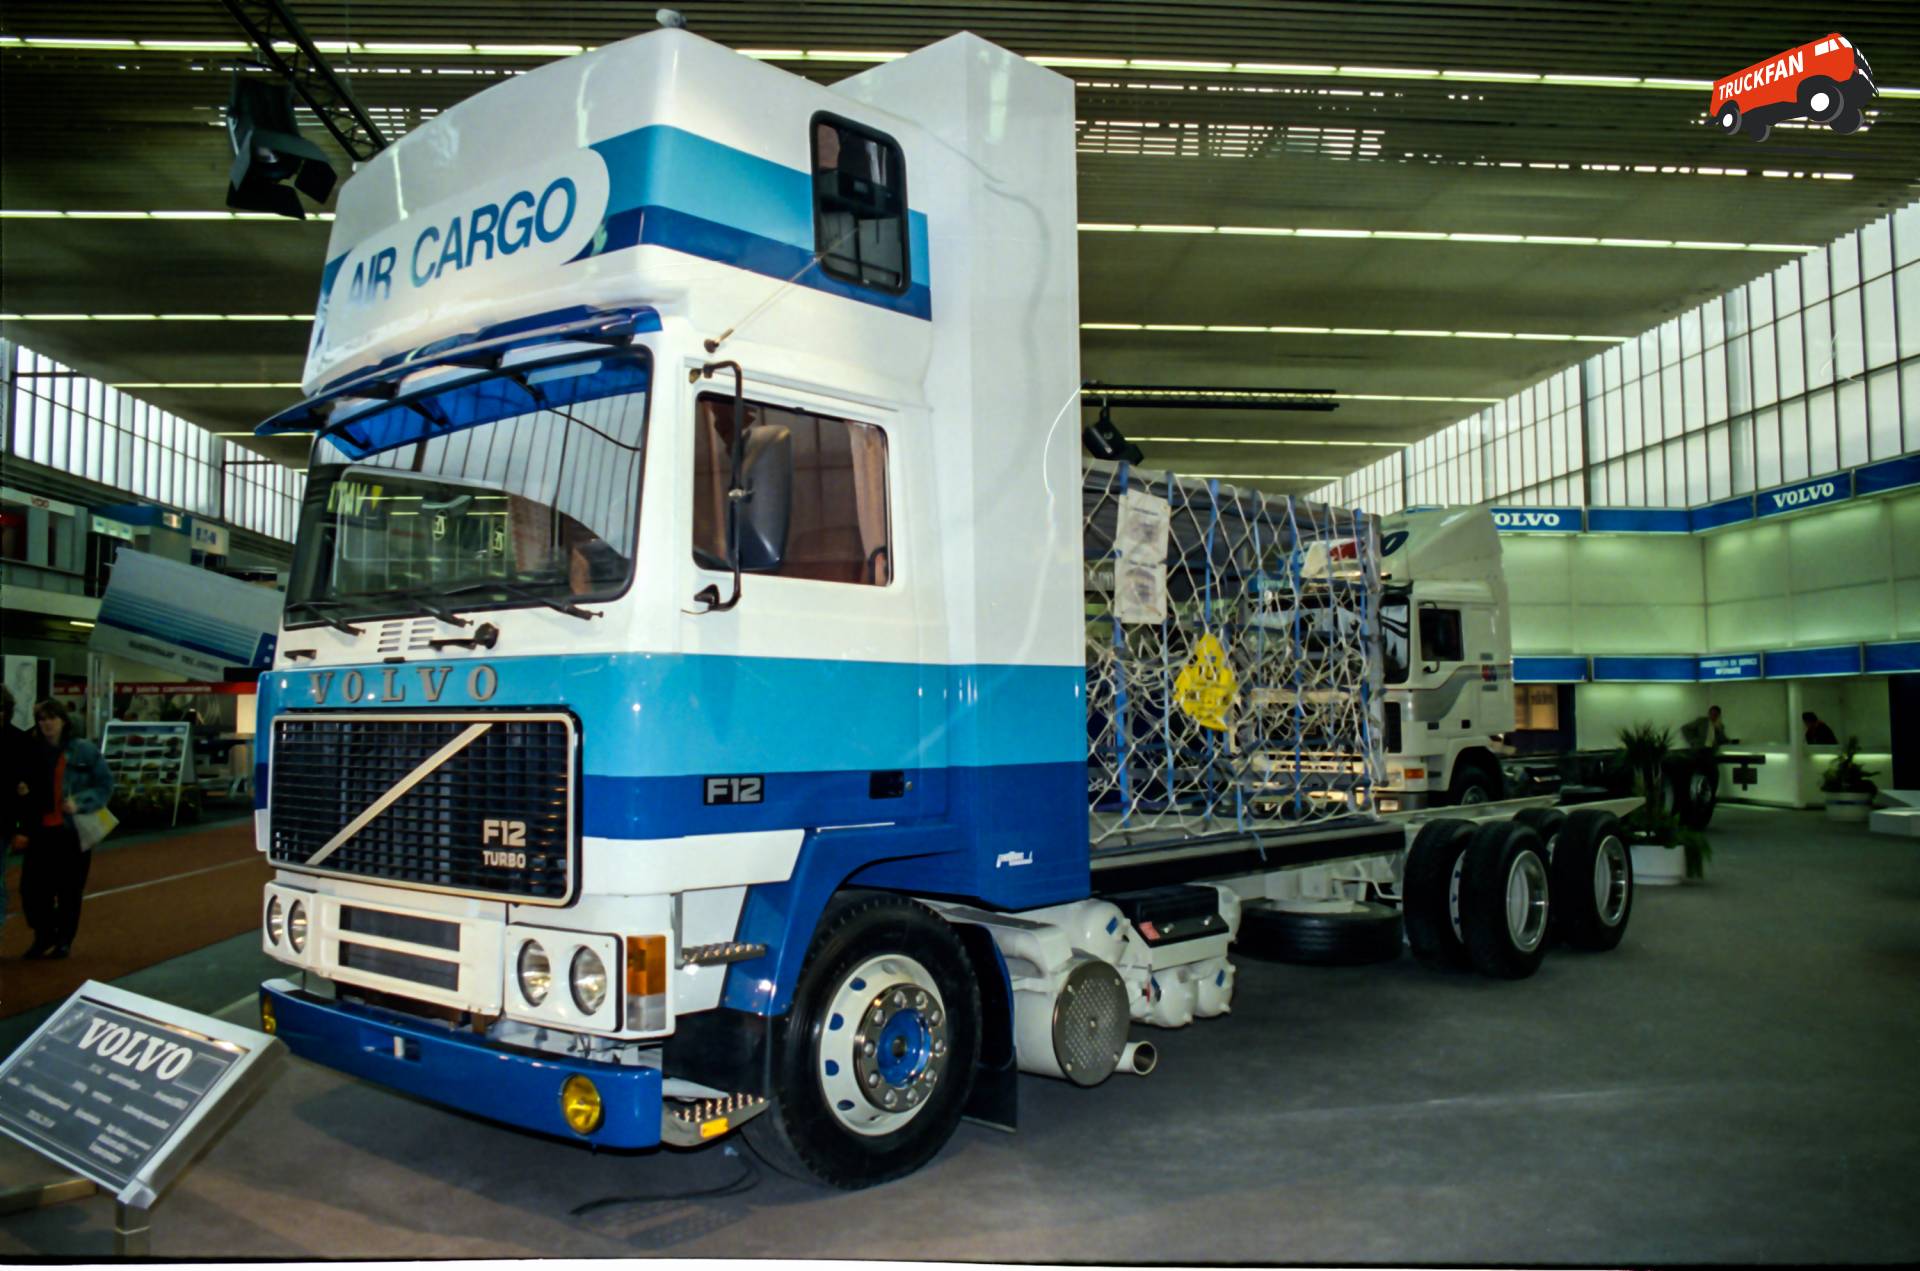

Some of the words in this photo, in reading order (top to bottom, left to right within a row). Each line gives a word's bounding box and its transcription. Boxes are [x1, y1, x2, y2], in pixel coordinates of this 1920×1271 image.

[348, 245, 397, 301] AIR
[410, 176, 577, 288] CARGO
[1772, 482, 1835, 509] VOLVO
[1491, 511, 1561, 527] OLVO
[308, 664, 499, 704] VOLVO
[706, 777, 762, 804] F12
[482, 819, 527, 847] F12
[482, 850, 527, 870] TURBO
[77, 1016, 194, 1081] VOLVO
